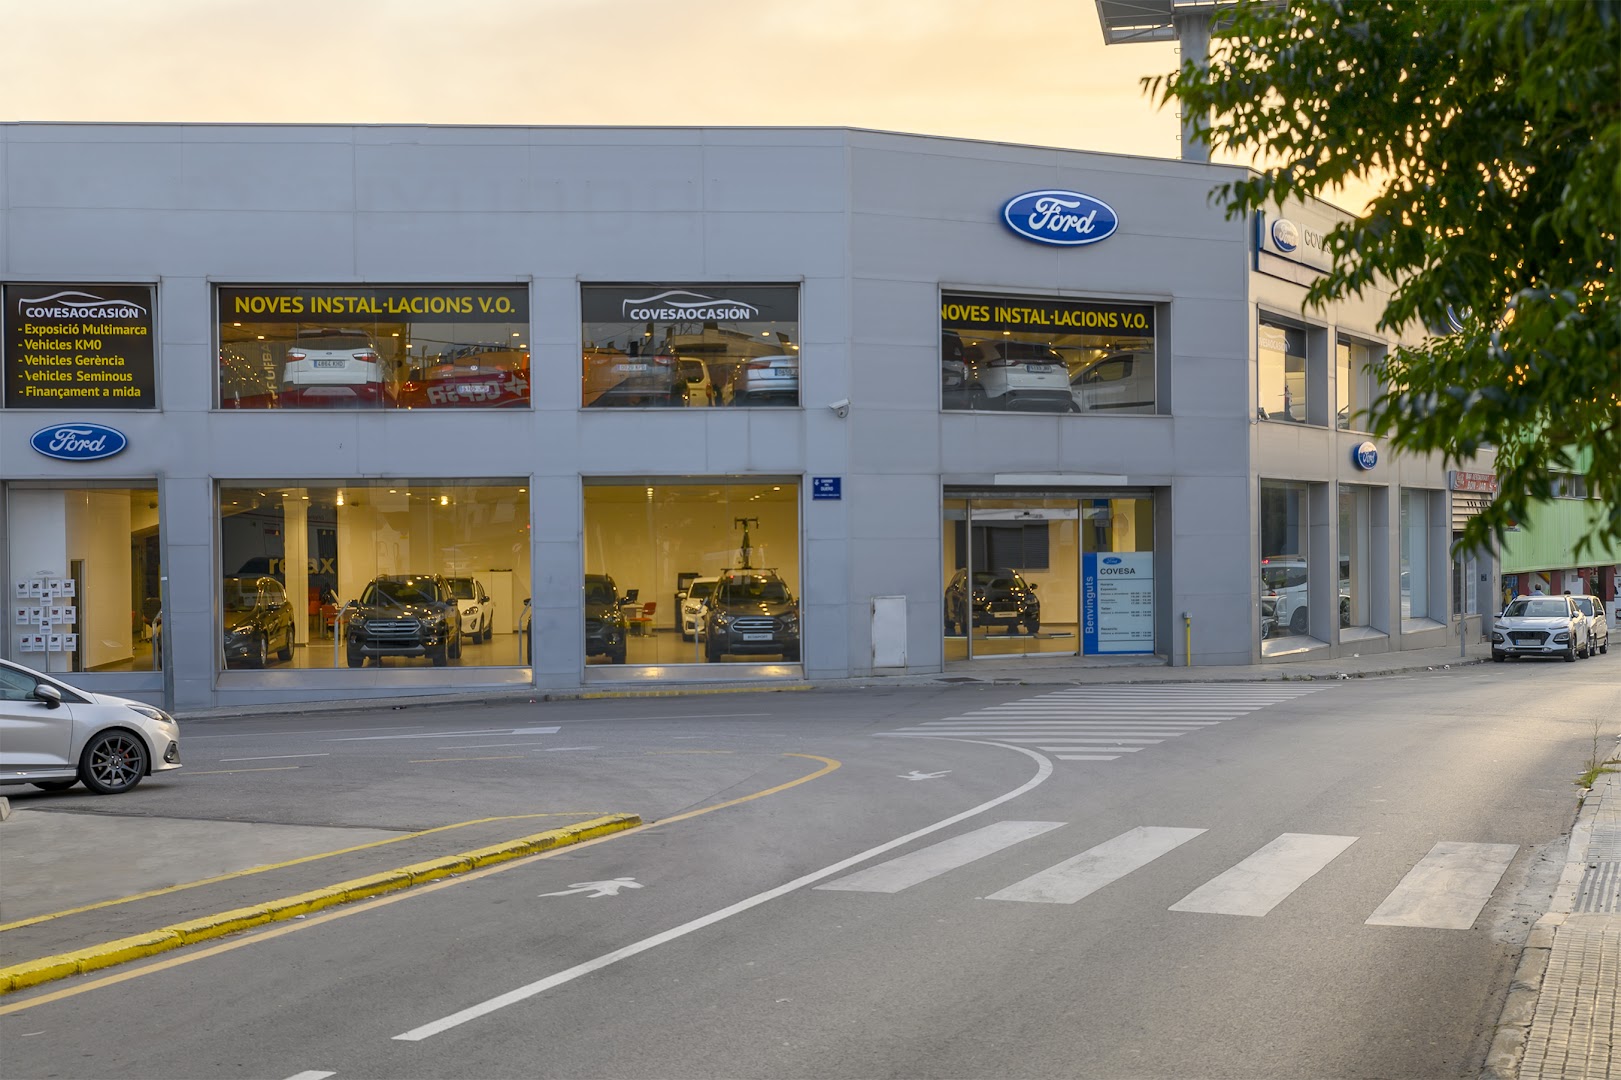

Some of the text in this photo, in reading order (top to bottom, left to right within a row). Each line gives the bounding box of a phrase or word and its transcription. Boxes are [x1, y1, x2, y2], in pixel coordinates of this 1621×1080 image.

[1028, 197, 1097, 234] Ford
[235, 296, 304, 313] NOVES
[478, 297, 516, 313] V.O.
[26, 306, 139, 319] COVESAOCASIÓN
[630, 306, 750, 320] COVESAOCASIÓN
[942, 304, 990, 322] NOVES
[1121, 313, 1149, 329] V.O.
[83, 323, 147, 335] Multimarca
[75, 353, 125, 366] Gerència
[76, 370, 133, 382] Seminous
[103, 388, 109, 397] a
[113, 385, 141, 397] mida
[49, 428, 107, 452] Ford
[269, 557, 335, 574] reax
[1100, 567, 1136, 575] COVESA
[1085, 576, 1096, 634] Benvinguts
